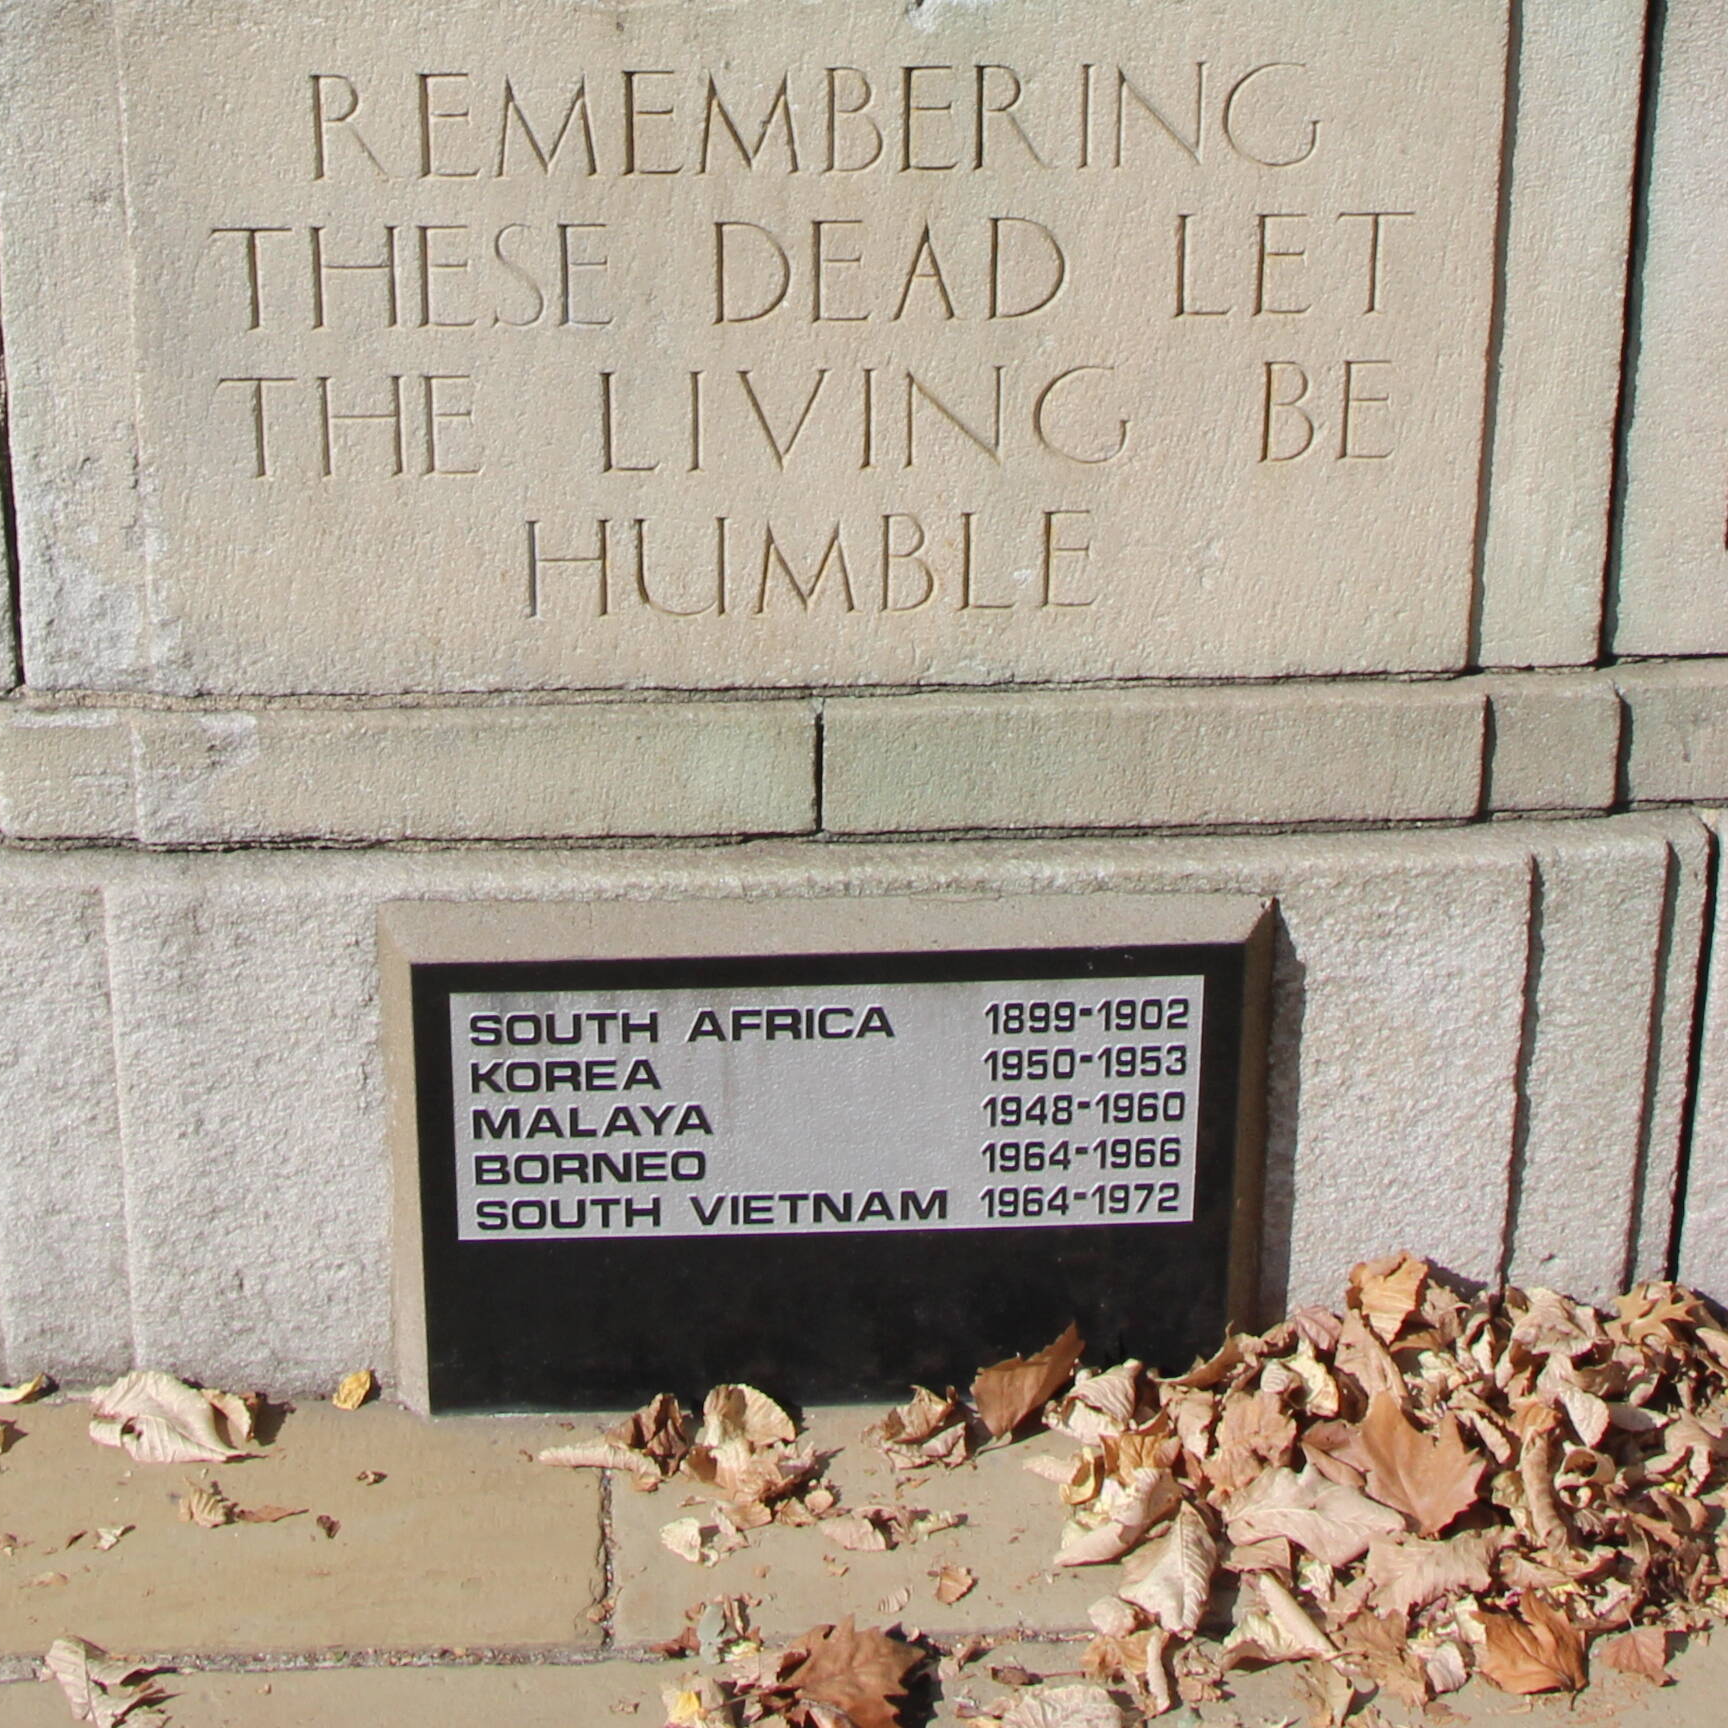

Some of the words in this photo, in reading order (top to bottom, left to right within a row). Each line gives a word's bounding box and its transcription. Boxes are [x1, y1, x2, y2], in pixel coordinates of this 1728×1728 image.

[309, 61, 1322, 182] REMEMBERING
[210, 220, 616, 333] THESE
[711, 215, 1068, 328] DEAD
[1173, 209, 1416, 320] LET
[218, 372, 484, 479] THE
[599, 364, 1131, 476] LIVING
[1257, 358, 1395, 465] BE
[523, 508, 1098, 621] HUMBLE
[469, 1010, 660, 1047] SOUTH
[687, 1006, 895, 1044] AFRICA
[984, 999, 1190, 1036] 1899-1902
[471, 1058, 662, 1093] KOREA
[983, 1045, 1187, 1081] 1950-1953
[471, 1104, 713, 1140] MALAYA
[981, 1092, 1187, 1128] 1948-1960
[474, 1151, 706, 1186] BORNEO
[981, 1138, 1182, 1174] 1964-1966
[476, 1196, 662, 1231] SOUTH
[689, 1189, 949, 1227] VIETNAM
[979, 1183, 1180, 1219] 1964-1972
